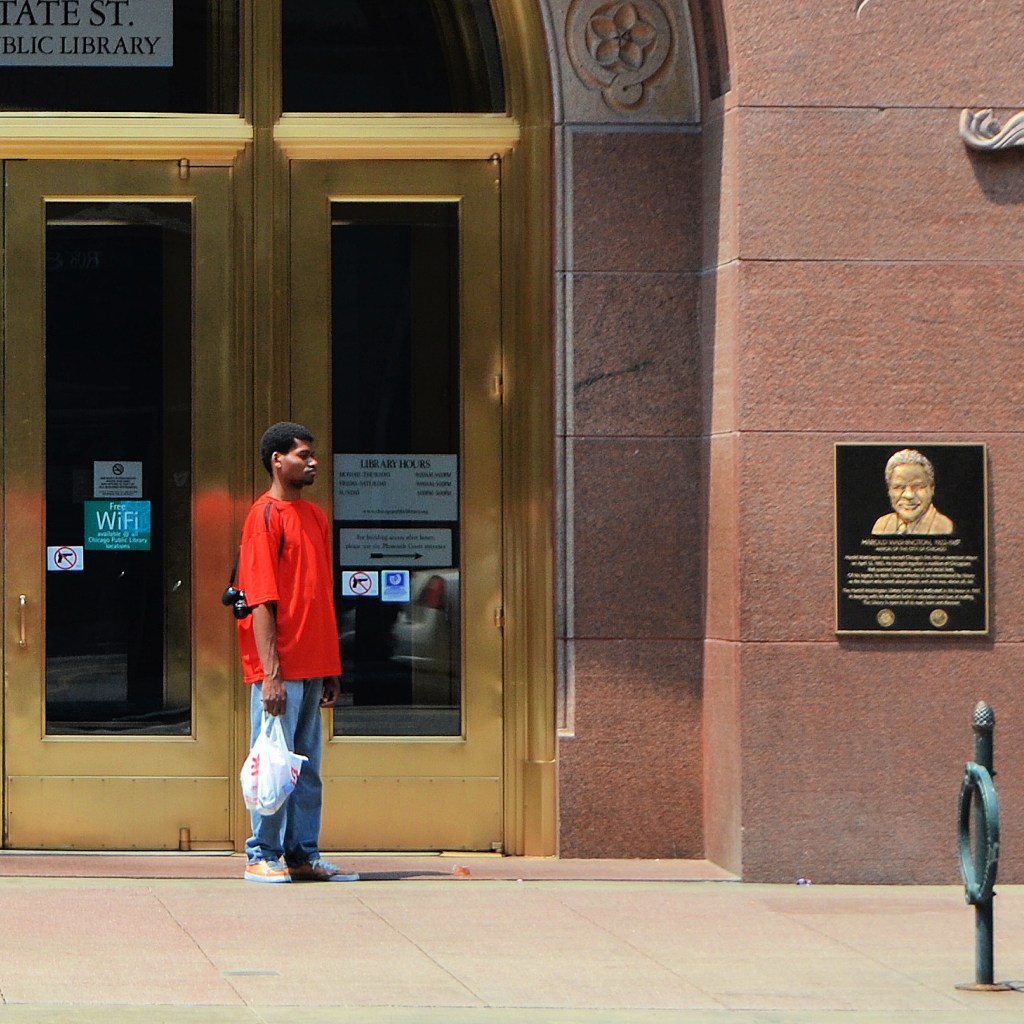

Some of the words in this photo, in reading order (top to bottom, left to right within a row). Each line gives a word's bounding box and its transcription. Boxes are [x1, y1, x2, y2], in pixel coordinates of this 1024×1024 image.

[60, 35, 161, 55] LIBRARY
[360, 459, 397, 468] LIBRARY
[400, 459, 431, 468] HOURS
[109, 502, 126, 510] Free
[96, 511, 138, 530] WiFi
